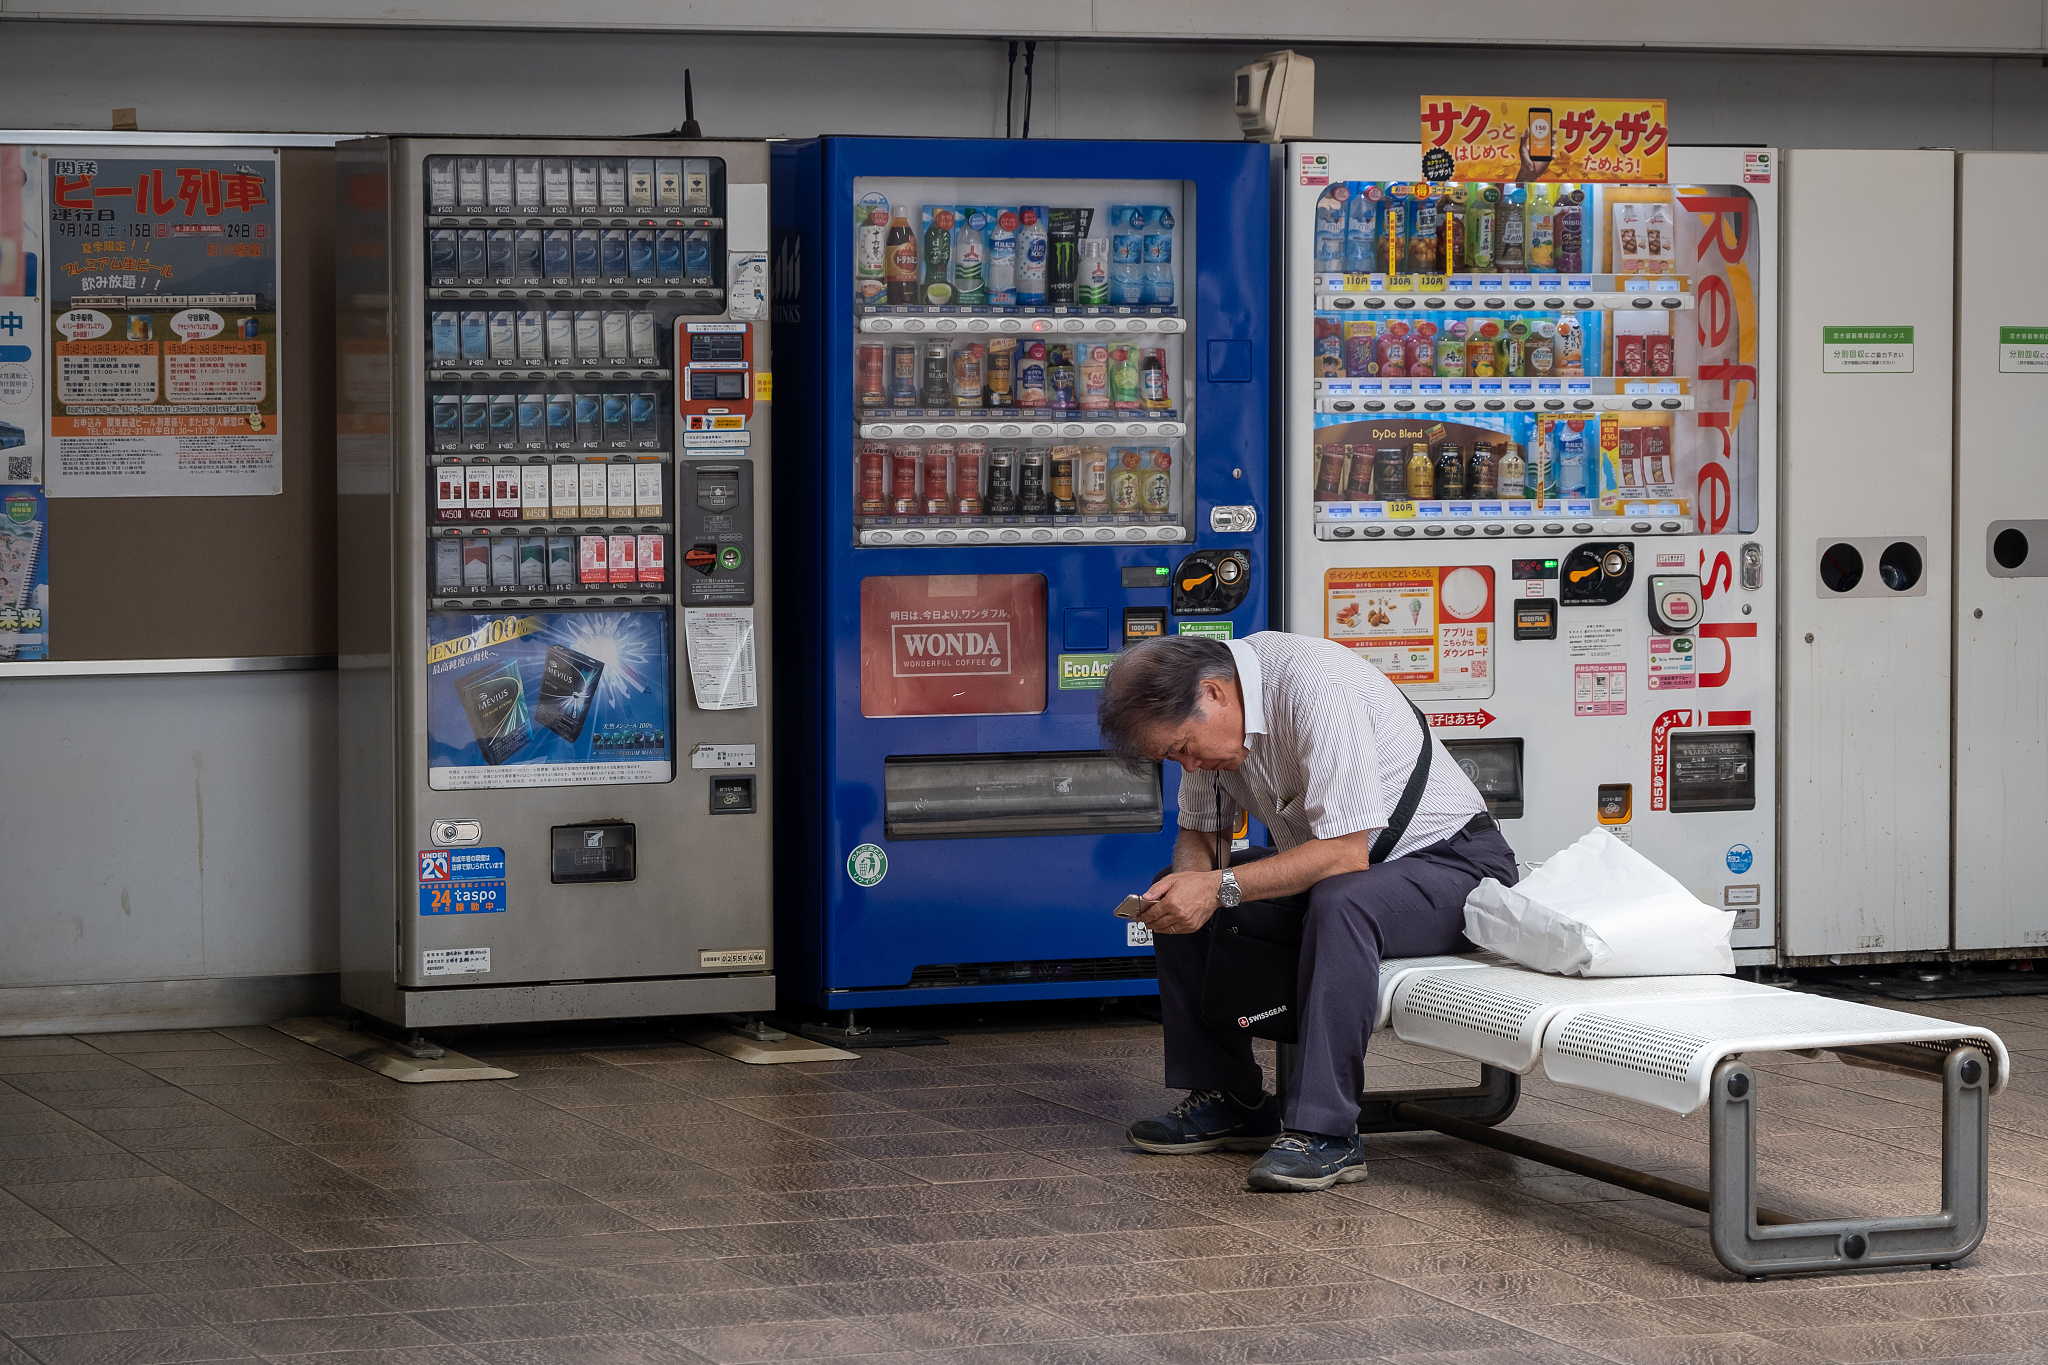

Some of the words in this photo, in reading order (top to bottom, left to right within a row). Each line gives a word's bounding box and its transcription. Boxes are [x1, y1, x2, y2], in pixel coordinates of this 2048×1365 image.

[1421, 102, 1516, 147] サクっと
[1534, 124, 1547, 132] 150
[1559, 108, 1668, 157] ザクザク
[1454, 144, 1516, 161] はじめて、
[56, 161, 97, 175] 関鉄
[1583, 156, 1640, 174] ためよう！
[54, 168, 268, 217] ビール列車
[52, 209, 115, 221] 運行日
[1328, 222, 1344, 230] miu
[1358, 222, 1374, 230] miu
[82, 240, 150, 253] 夏季限定！！
[871, 229, 881, 259] 十六茶
[61, 257, 172, 277] プレミアム生ビール
[81, 275, 160, 291] 飲み放題！！
[1346, 276, 1368, 286] 110円
[1390, 276, 1411, 286] 130円
[1422, 276, 1443, 286] 130円
[0, 311, 23, 337] 中
[1834, 332, 1905, 340] 空き容器専用回収ボックス
[1834, 350, 1904, 358] 分別回収にご協力下さい
[73, 418, 102, 427] お申込み
[87, 428, 100, 436] TEL
[1372, 429, 1397, 440] DyDo
[1399, 428, 1423, 438] Blend
[1650, 440, 1664, 448] chip
[1620, 448, 1635, 456] star
[1124, 475, 1134, 506] 十六茶
[1155, 475, 1164, 506] 十六茶
[1390, 503, 1413, 512] 120円
[1328, 568, 1434, 580] ポイントためて、いいこといろいろ。
[0, 608, 42, 630] 未来
[890, 609, 1012, 621] 明日は、今日より、ワンダフル。
[432, 636, 479, 660] ENJOY
[483, 616, 528, 645] 100%
[1442, 628, 1474, 638] アプリは
[902, 632, 1000, 657] WONDA
[1443, 638, 1475, 647] こちらから
[1442, 647, 1488, 658] ダウンロード
[432, 650, 501, 675] 最高純度の爽快へ。
[903, 660, 952, 668] WONDERFUL
[546, 666, 573, 684] MEVIUS
[477, 688, 509, 710] MEVIUS
[851, 846, 884, 862] のんだあとは
[422, 858, 448, 880] 20
[452, 862, 504, 871] 法律で禁じられています
[853, 872, 882, 885] リサイクル
[432, 890, 452, 907] 24
[454, 890, 496, 904] taspo
[1248, 1004, 1288, 1024] SWISSGEAR
